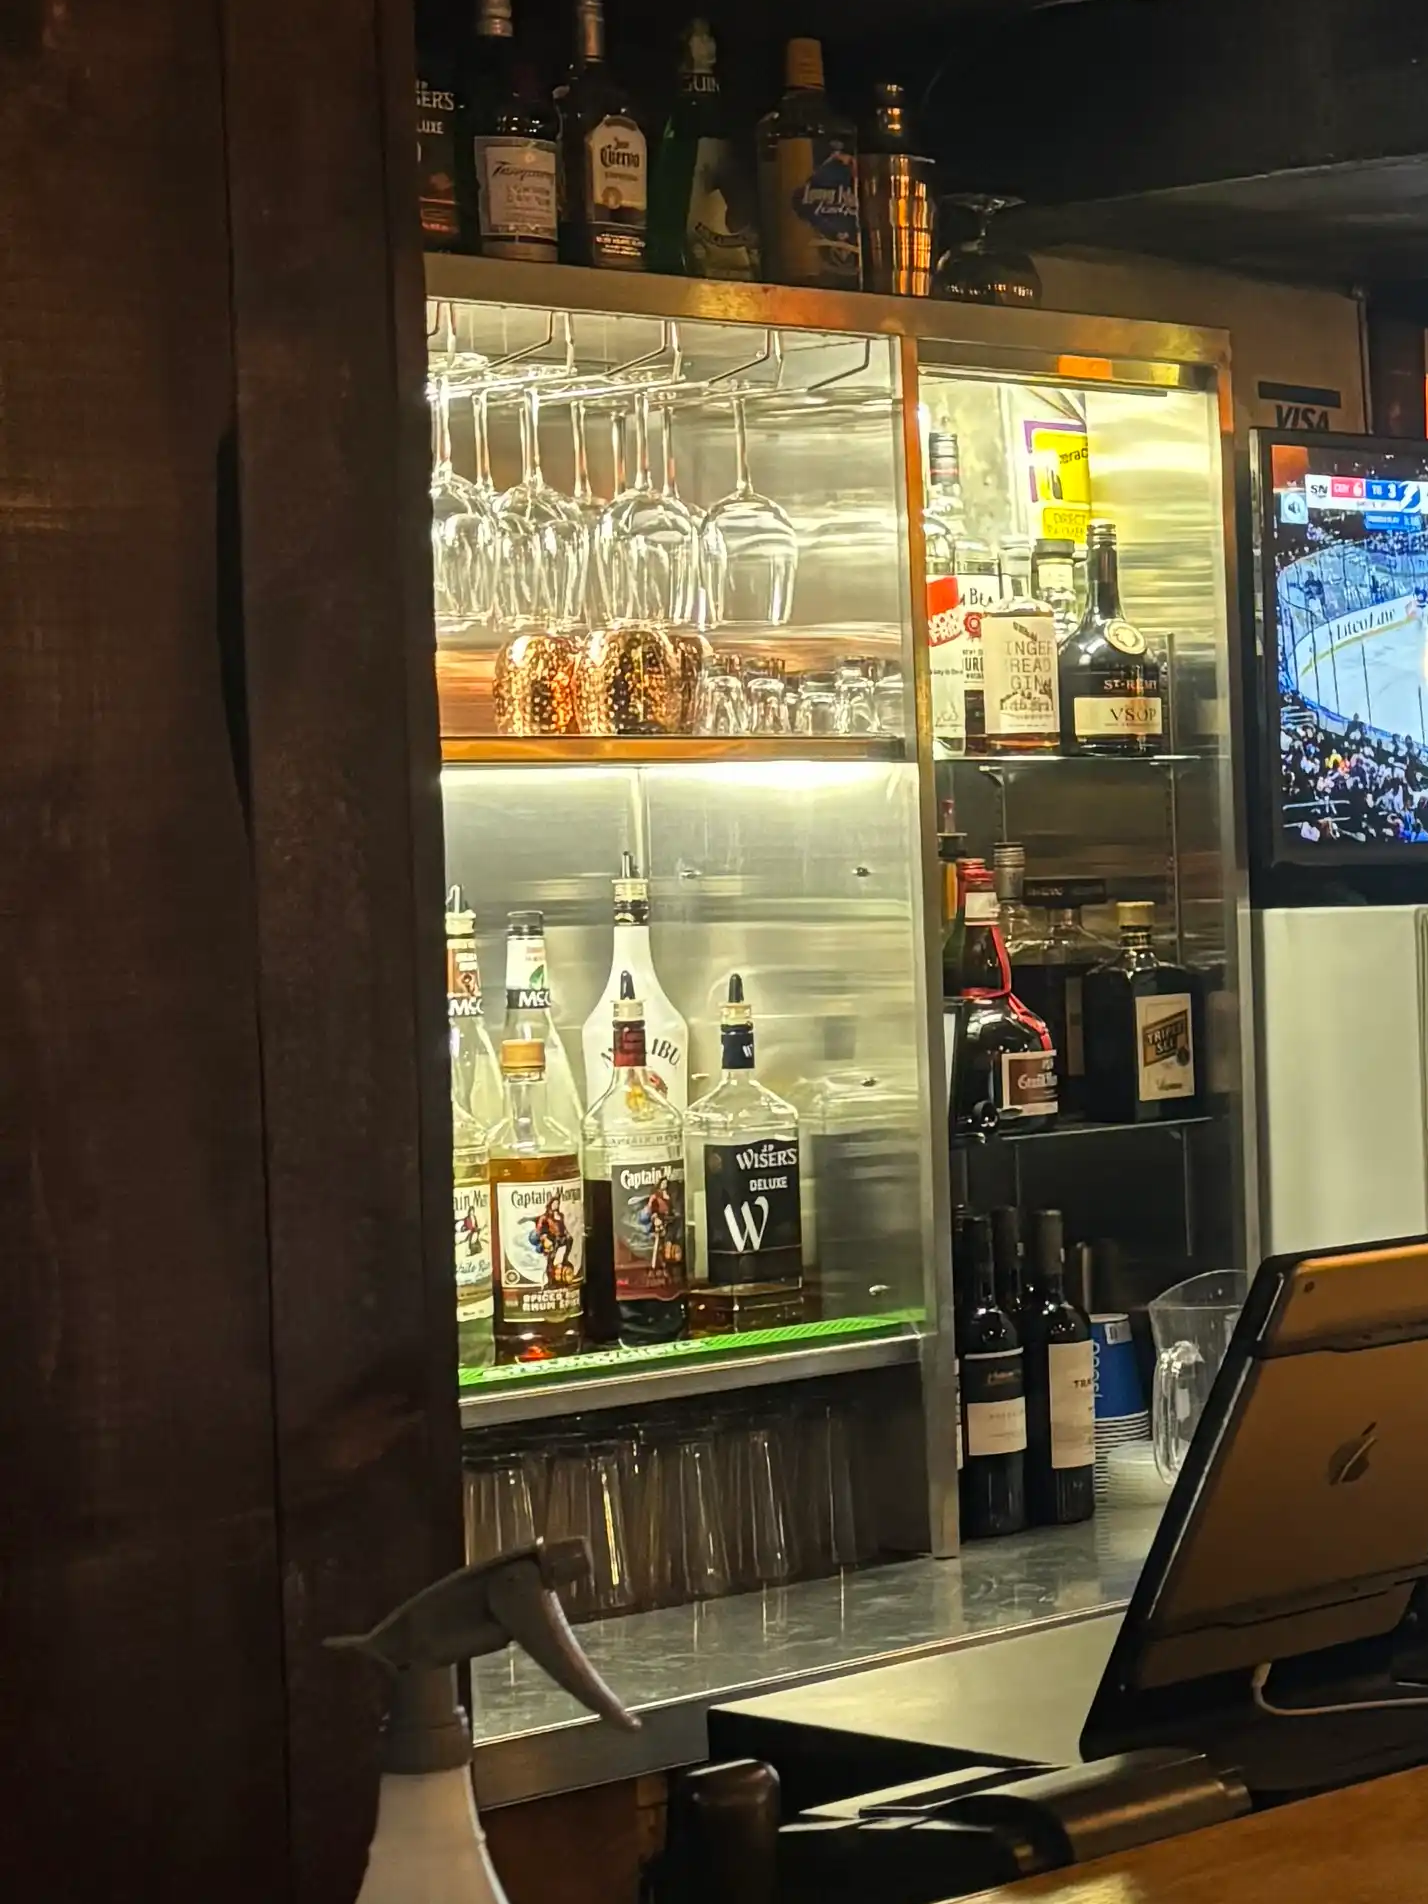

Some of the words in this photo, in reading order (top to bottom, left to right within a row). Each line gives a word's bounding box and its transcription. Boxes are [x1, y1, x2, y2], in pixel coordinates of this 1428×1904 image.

[1275, 405, 1332, 431] VISA
[1387, 483, 1397, 499] 3
[1109, 707, 1157, 722] VSOP
[620, 1168, 661, 1190] Captain
[749, 1176, 788, 1192] DELUXE
[511, 1188, 553, 1209] Captain
[723, 1196, 770, 1253] W
